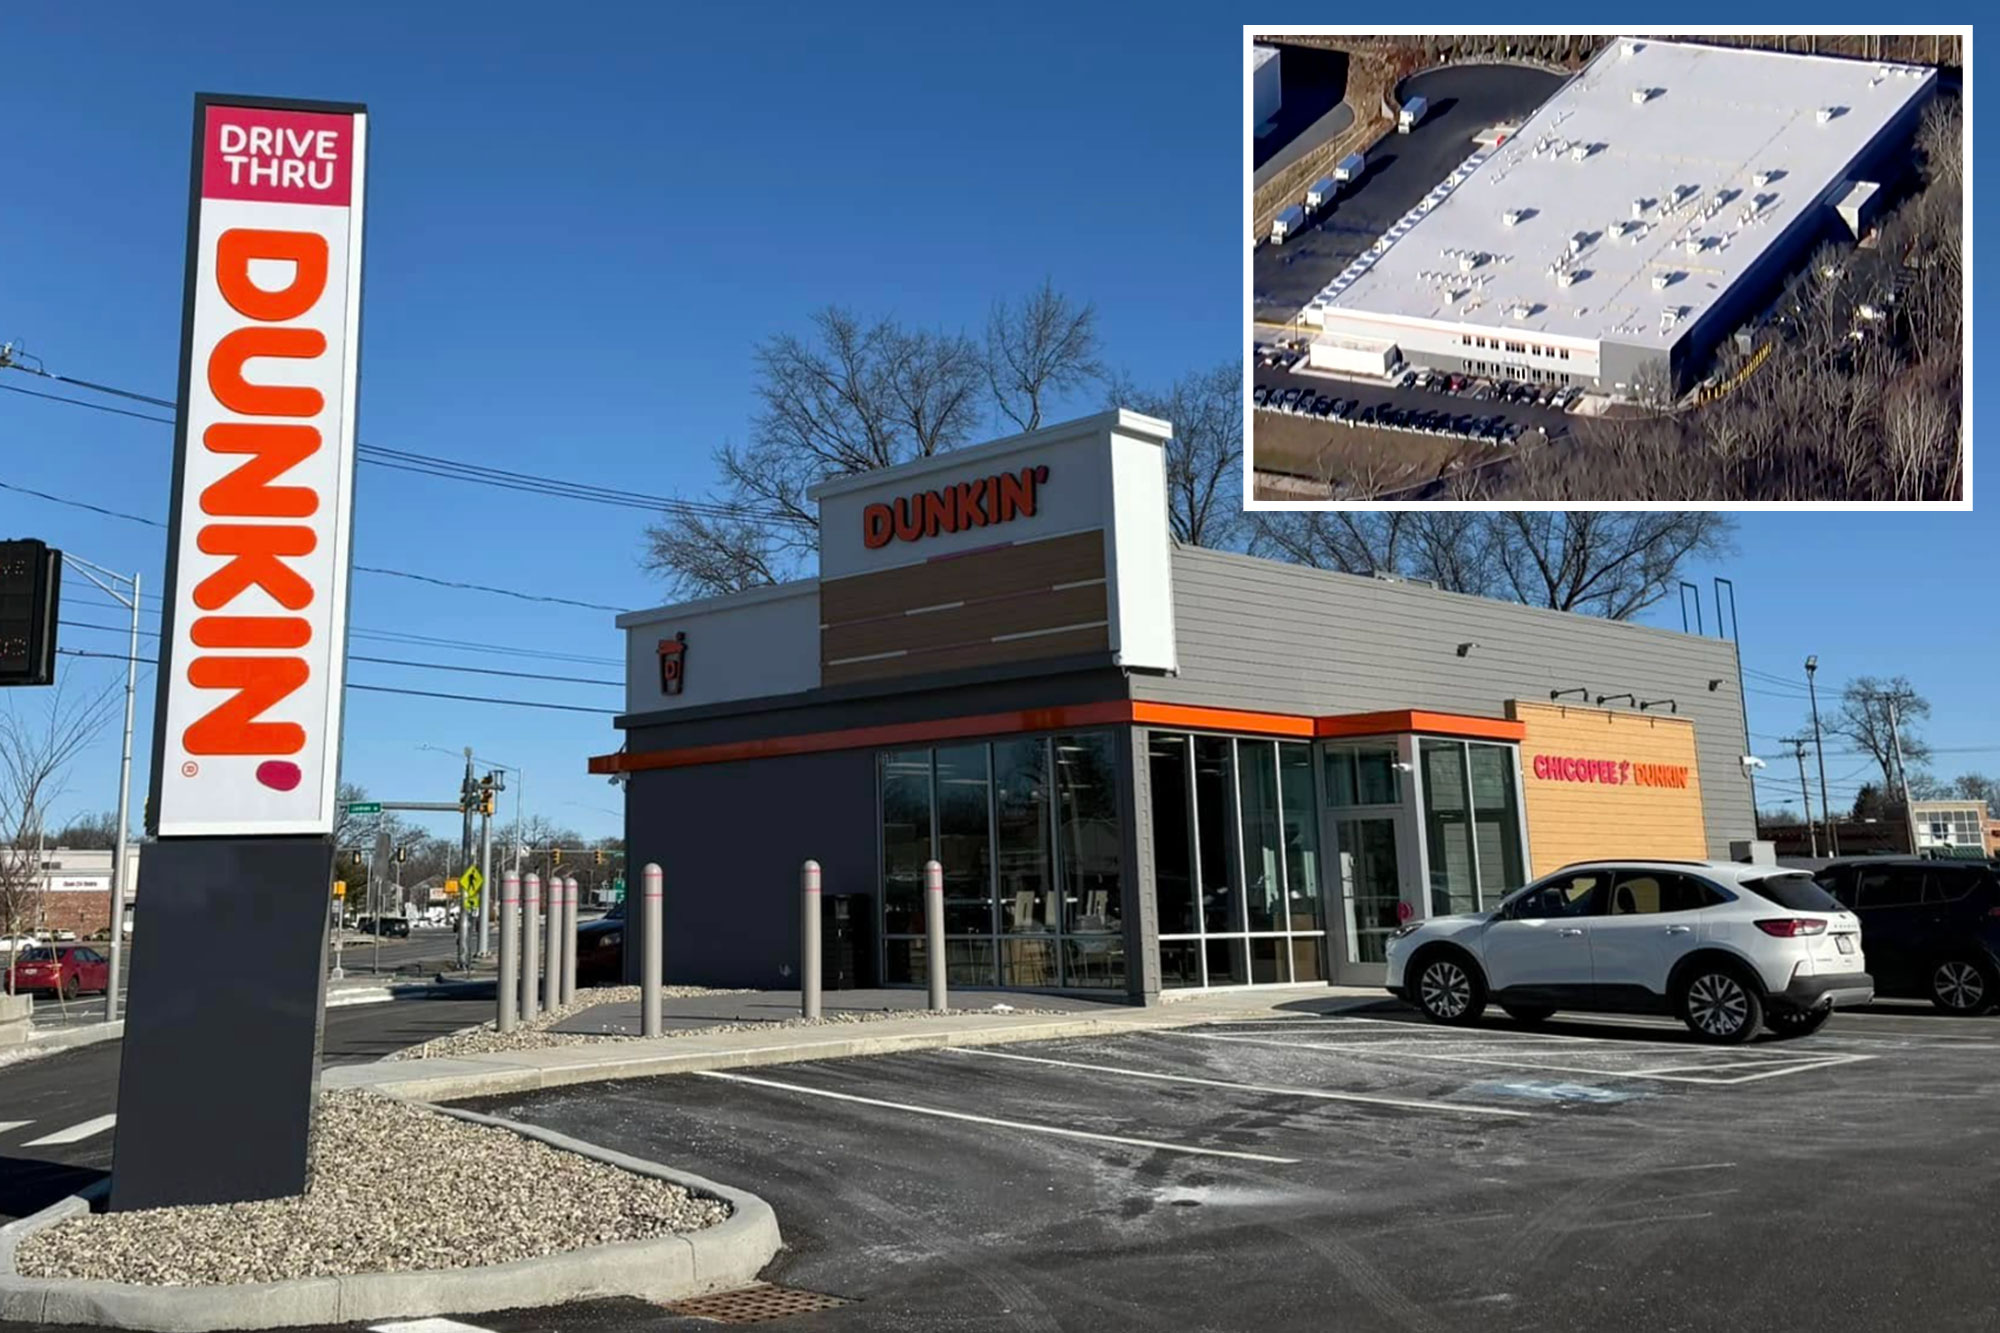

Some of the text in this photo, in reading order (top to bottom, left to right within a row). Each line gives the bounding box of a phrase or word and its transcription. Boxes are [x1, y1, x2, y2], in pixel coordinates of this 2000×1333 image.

[220, 124, 339, 160] DRIVE
[223, 155, 334, 190] THRU
[182, 228, 329, 791] DUNKIN'
[863, 465, 1049, 549] DUNKIN'
[1533, 754, 1688, 789] CHICOPEE DUNKIN'
